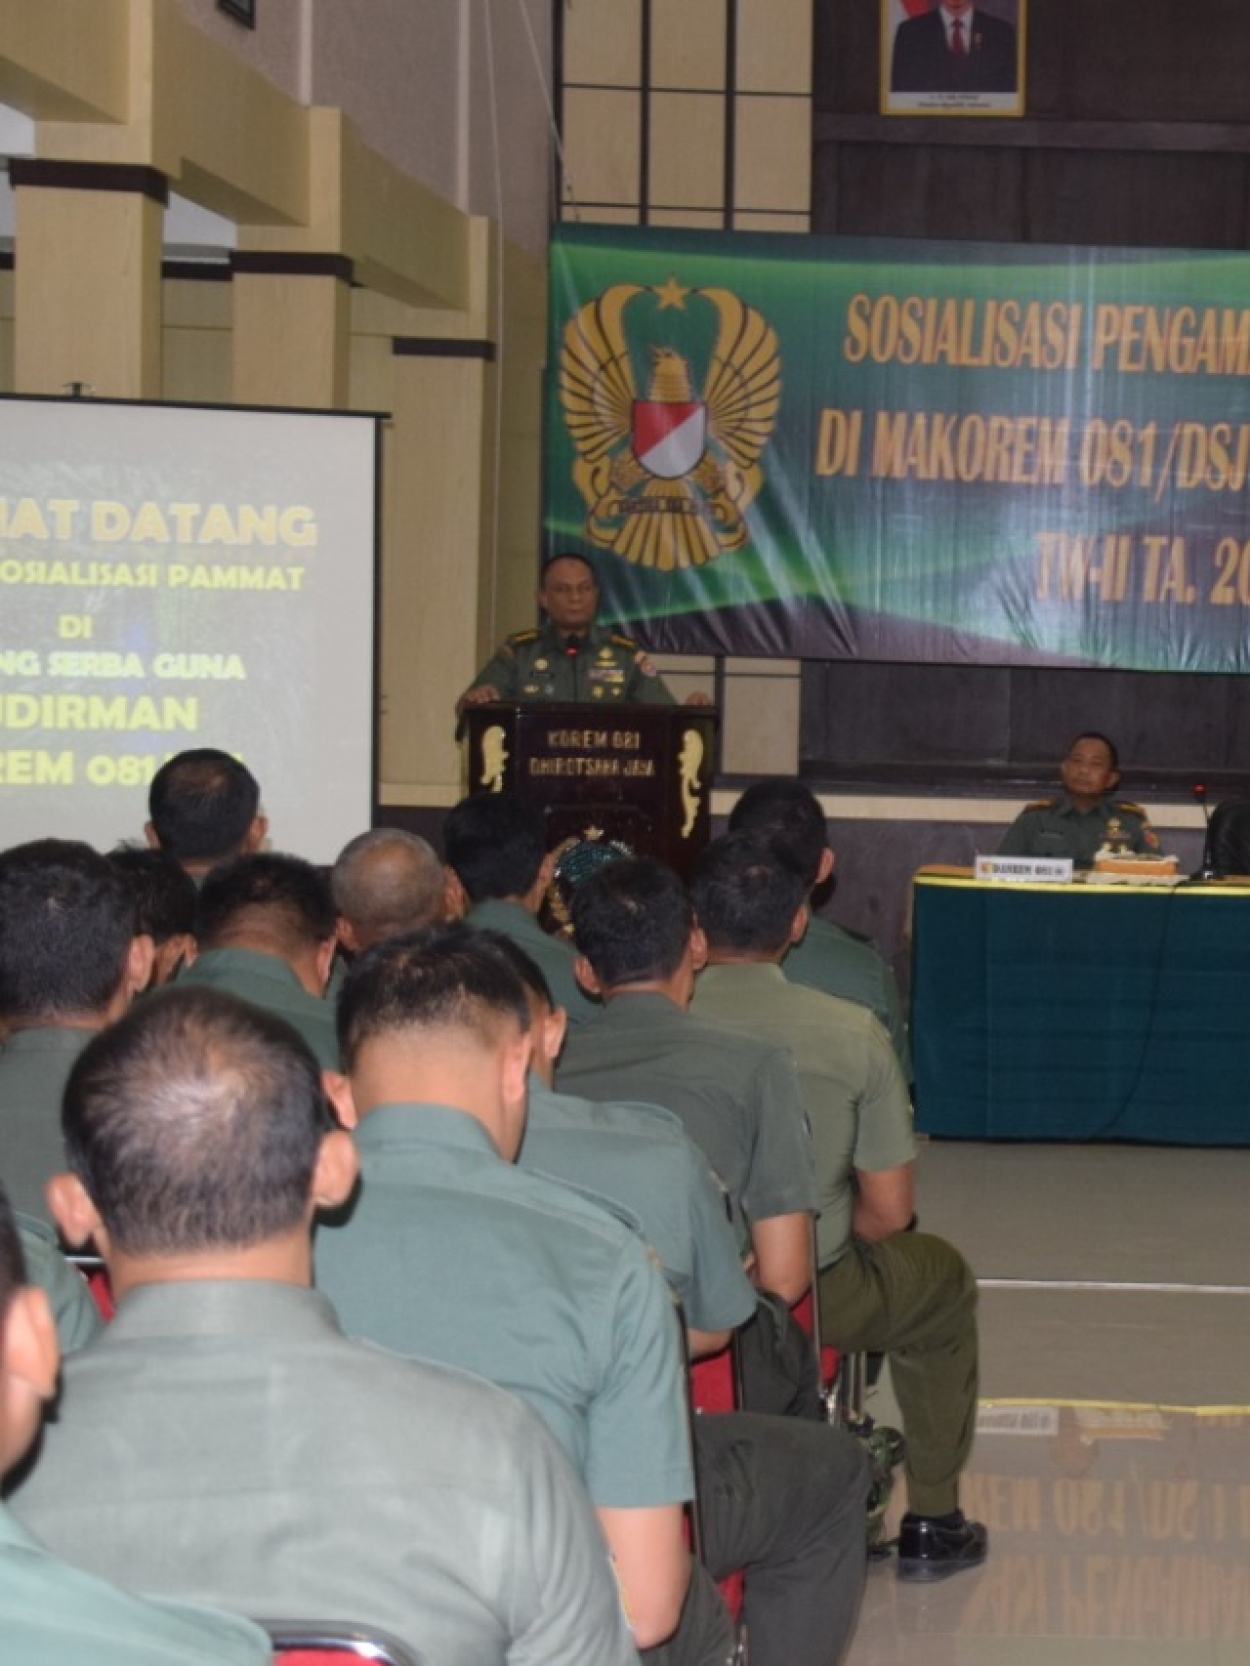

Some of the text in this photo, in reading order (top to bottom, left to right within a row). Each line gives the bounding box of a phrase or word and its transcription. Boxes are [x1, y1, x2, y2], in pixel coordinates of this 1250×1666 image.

[844, 293, 1082, 370] SOSIALISASI
[815, 408, 862, 477] DI
[870, 410, 1070, 486] MAKOREM
[1077, 416, 1250, 503] 081/DSJ
[0, 498, 319, 546] AT DATANG
[0, 559, 305, 591] OSIALISASI PAMMAT
[1142, 535, 1196, 605] TA.
[58, 614, 93, 639] DI
[47, 651, 145, 679] SERBA
[153, 653, 247, 681] GUNA
[0, 693, 198, 731] DIRMAN
[0, 749, 75, 786] EM
